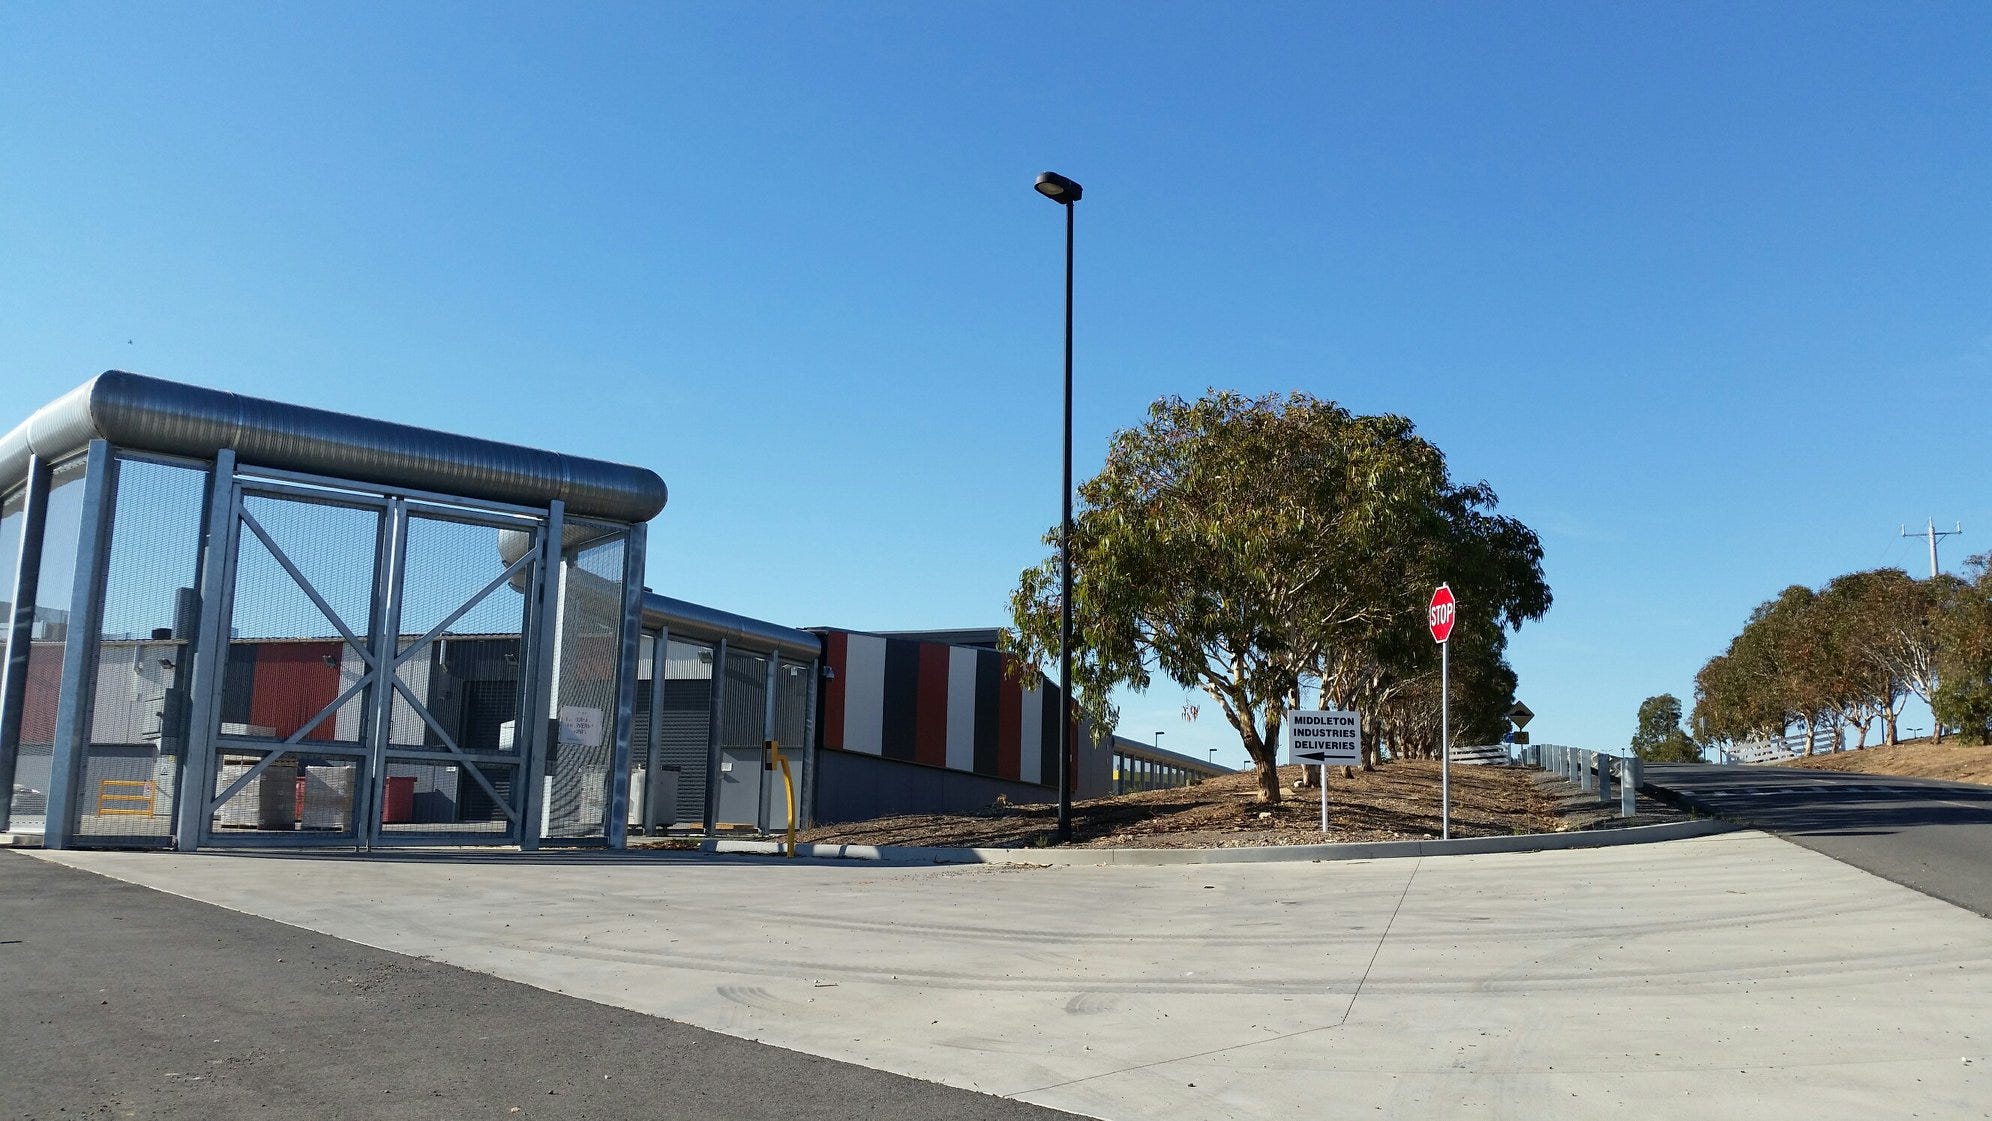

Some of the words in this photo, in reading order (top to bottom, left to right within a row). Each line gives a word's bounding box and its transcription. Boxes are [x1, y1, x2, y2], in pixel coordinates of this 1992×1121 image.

[1431, 602, 1453, 627] STOP
[1294, 716, 1355, 726] MIDDLETON
[1293, 728, 1356, 738] INDUSTRIES
[1294, 740, 1355, 750] DELIVERIES
